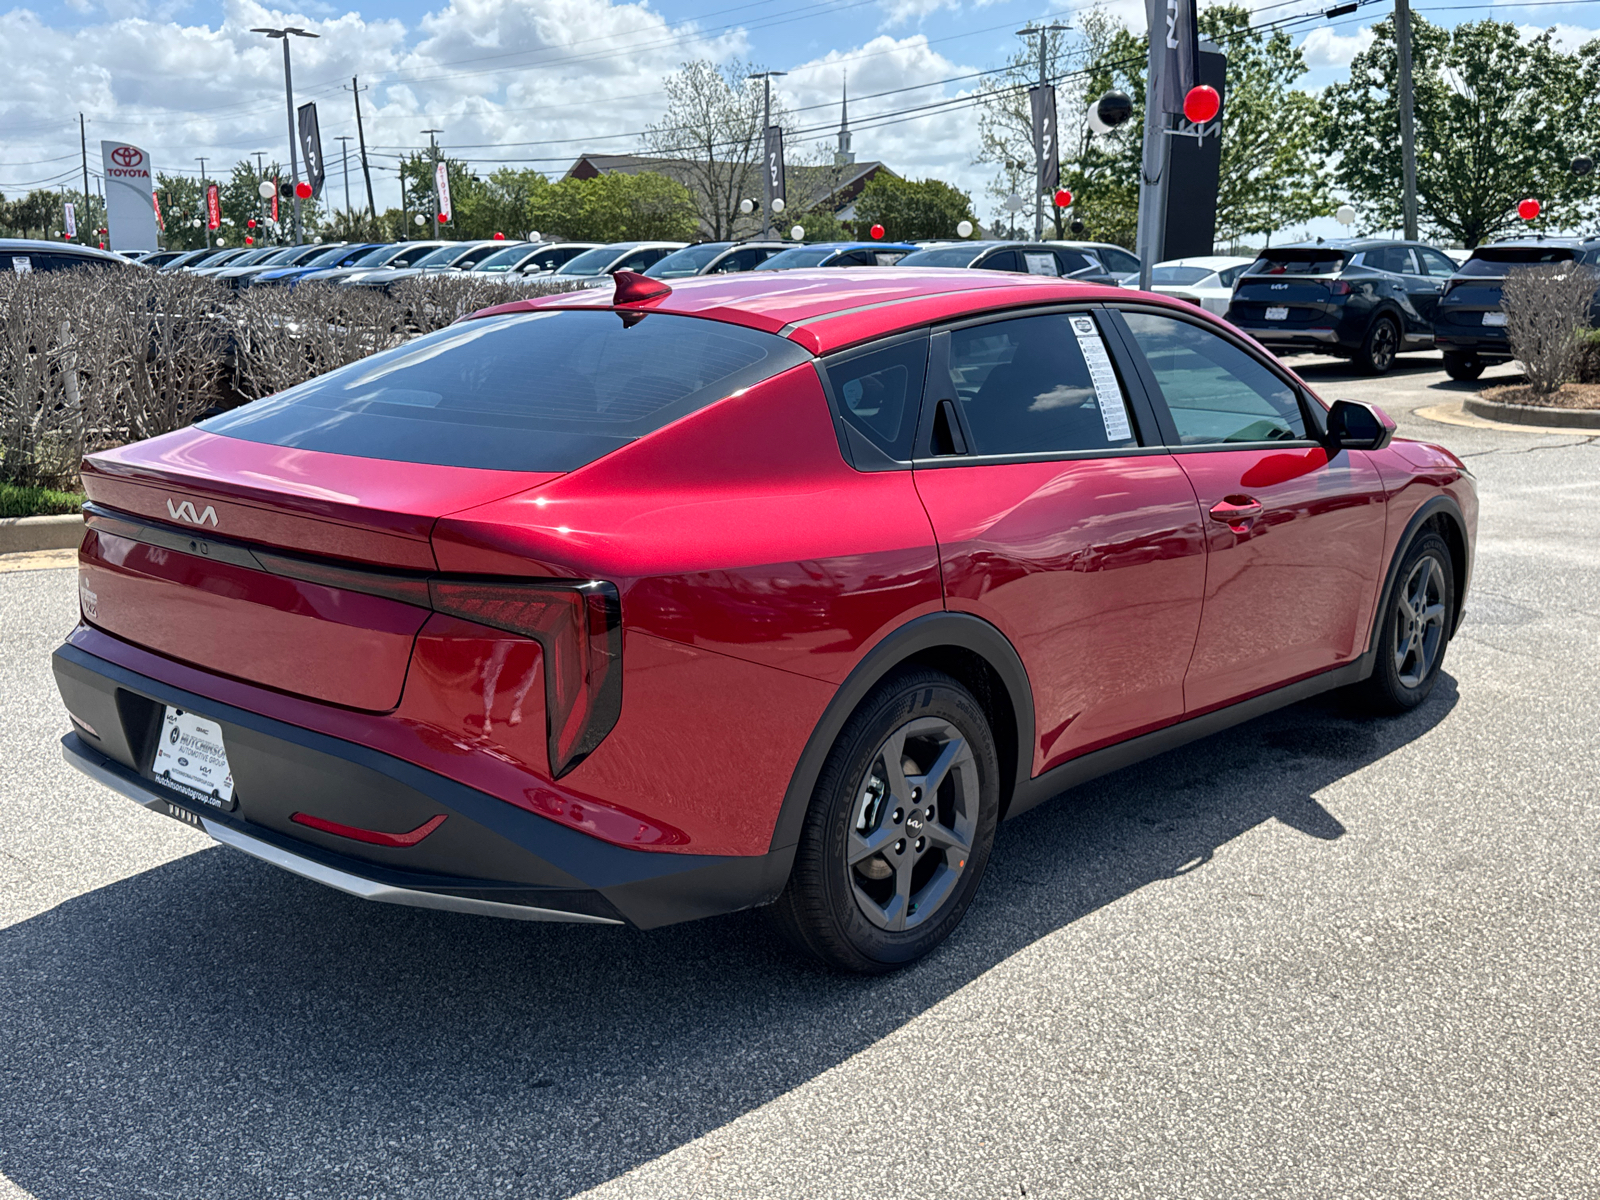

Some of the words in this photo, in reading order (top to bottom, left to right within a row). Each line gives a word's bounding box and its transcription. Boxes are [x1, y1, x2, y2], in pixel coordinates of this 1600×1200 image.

[107, 168, 149, 178] TOYOTA
[209, 193, 219, 226] TOYOTA
[166, 498, 219, 528] KIA
[178, 745, 209, 762] AUTOMOTIVE
[208, 756, 226, 767] GROUP
[835, 770, 859, 858] SOLUS
[907, 818, 923, 829] KIA
